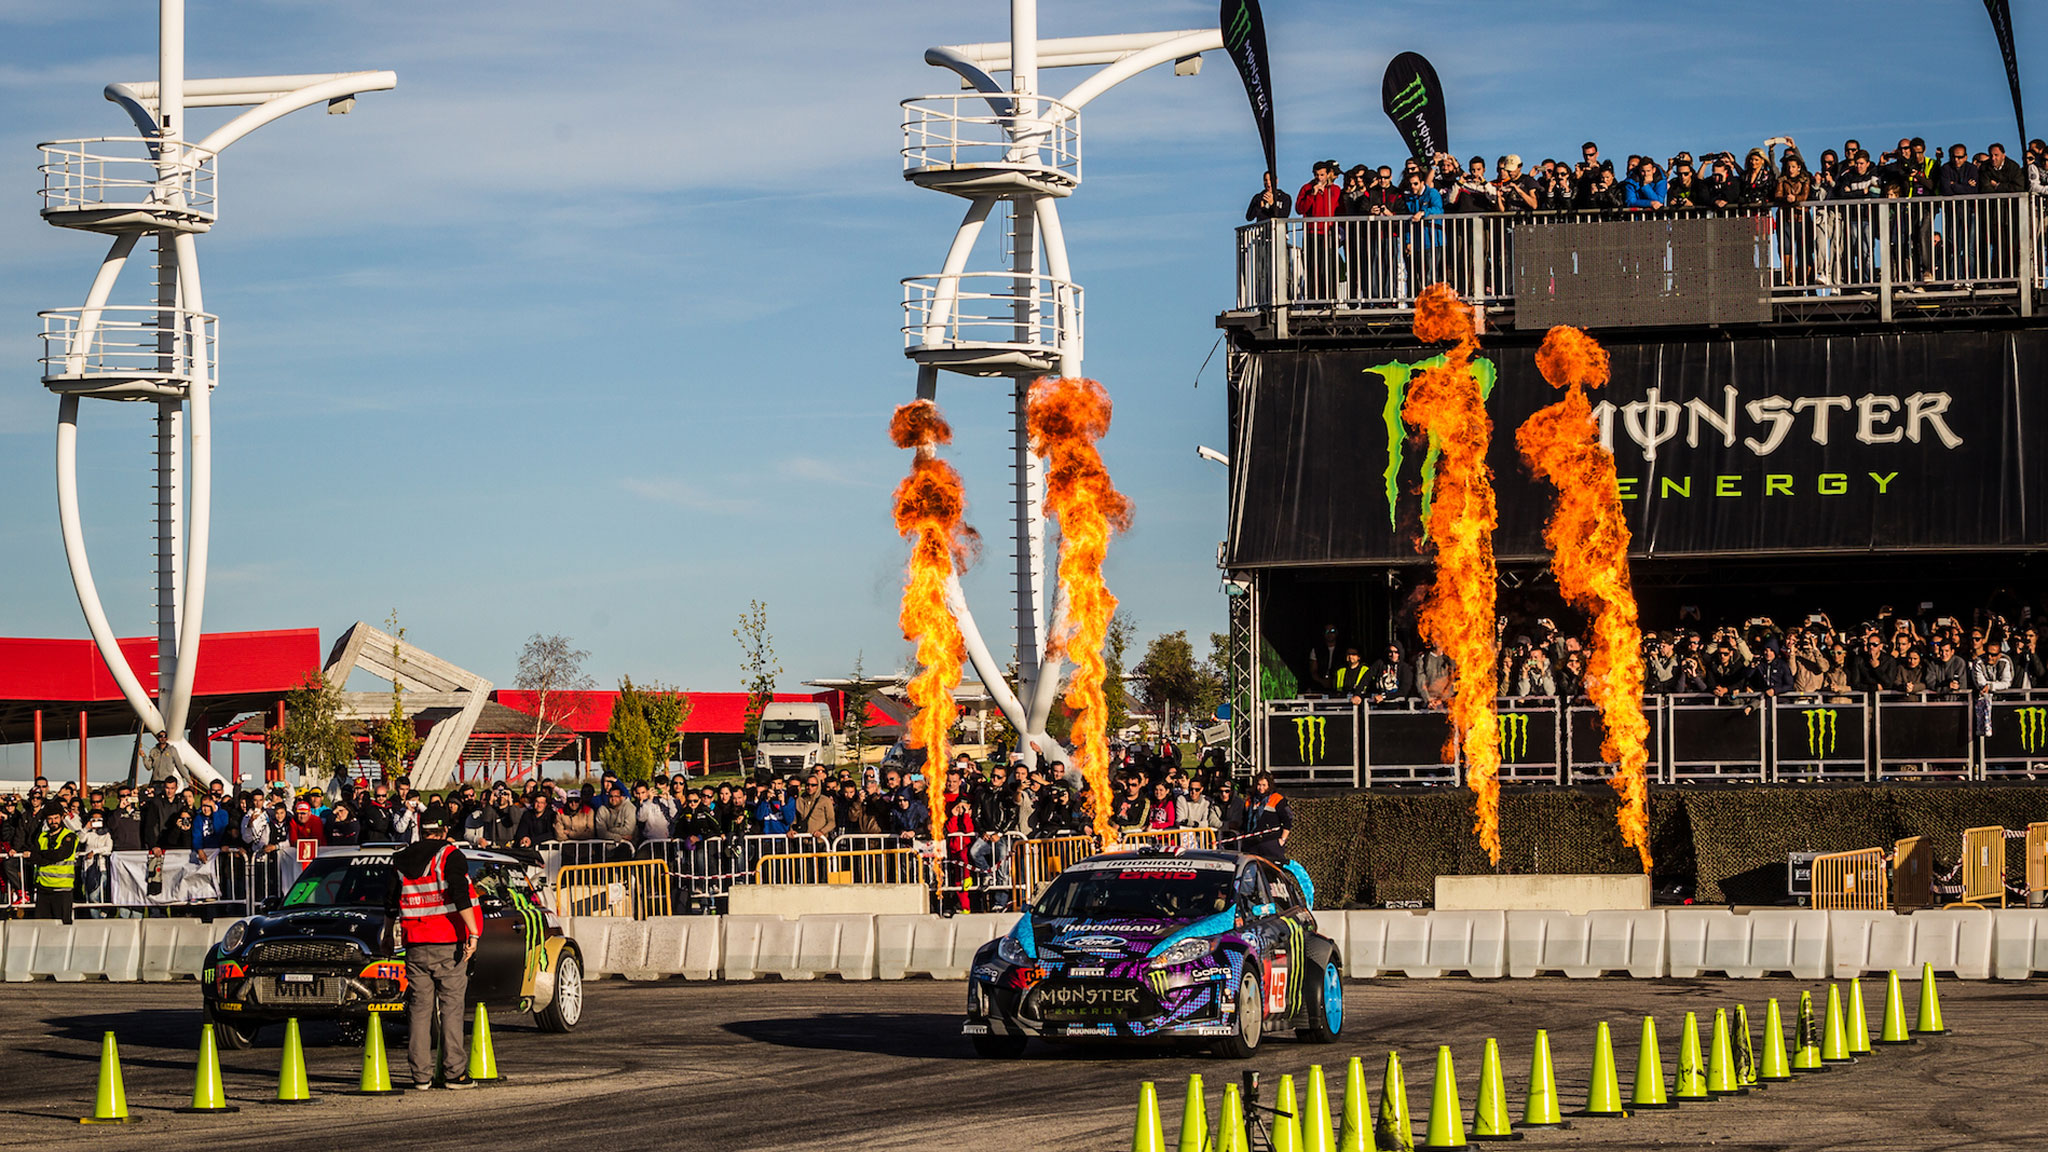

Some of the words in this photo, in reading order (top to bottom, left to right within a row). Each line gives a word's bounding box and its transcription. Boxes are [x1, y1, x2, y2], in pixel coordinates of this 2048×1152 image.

[1244, 39, 1269, 118] MONSTER
[1616, 471, 1899, 499] ENERGY
[1118, 871, 1198, 880] GRID
[1070, 967, 1106, 976] PIRELLI
[1192, 966, 1232, 978] GoPro
[275, 978, 325, 997] MINI
[1039, 984, 1139, 1005] MONSTER
[1272, 972, 1286, 1008] 43
[220, 1002, 243, 1011] GALFER
[368, 1002, 405, 1012] GALFER
